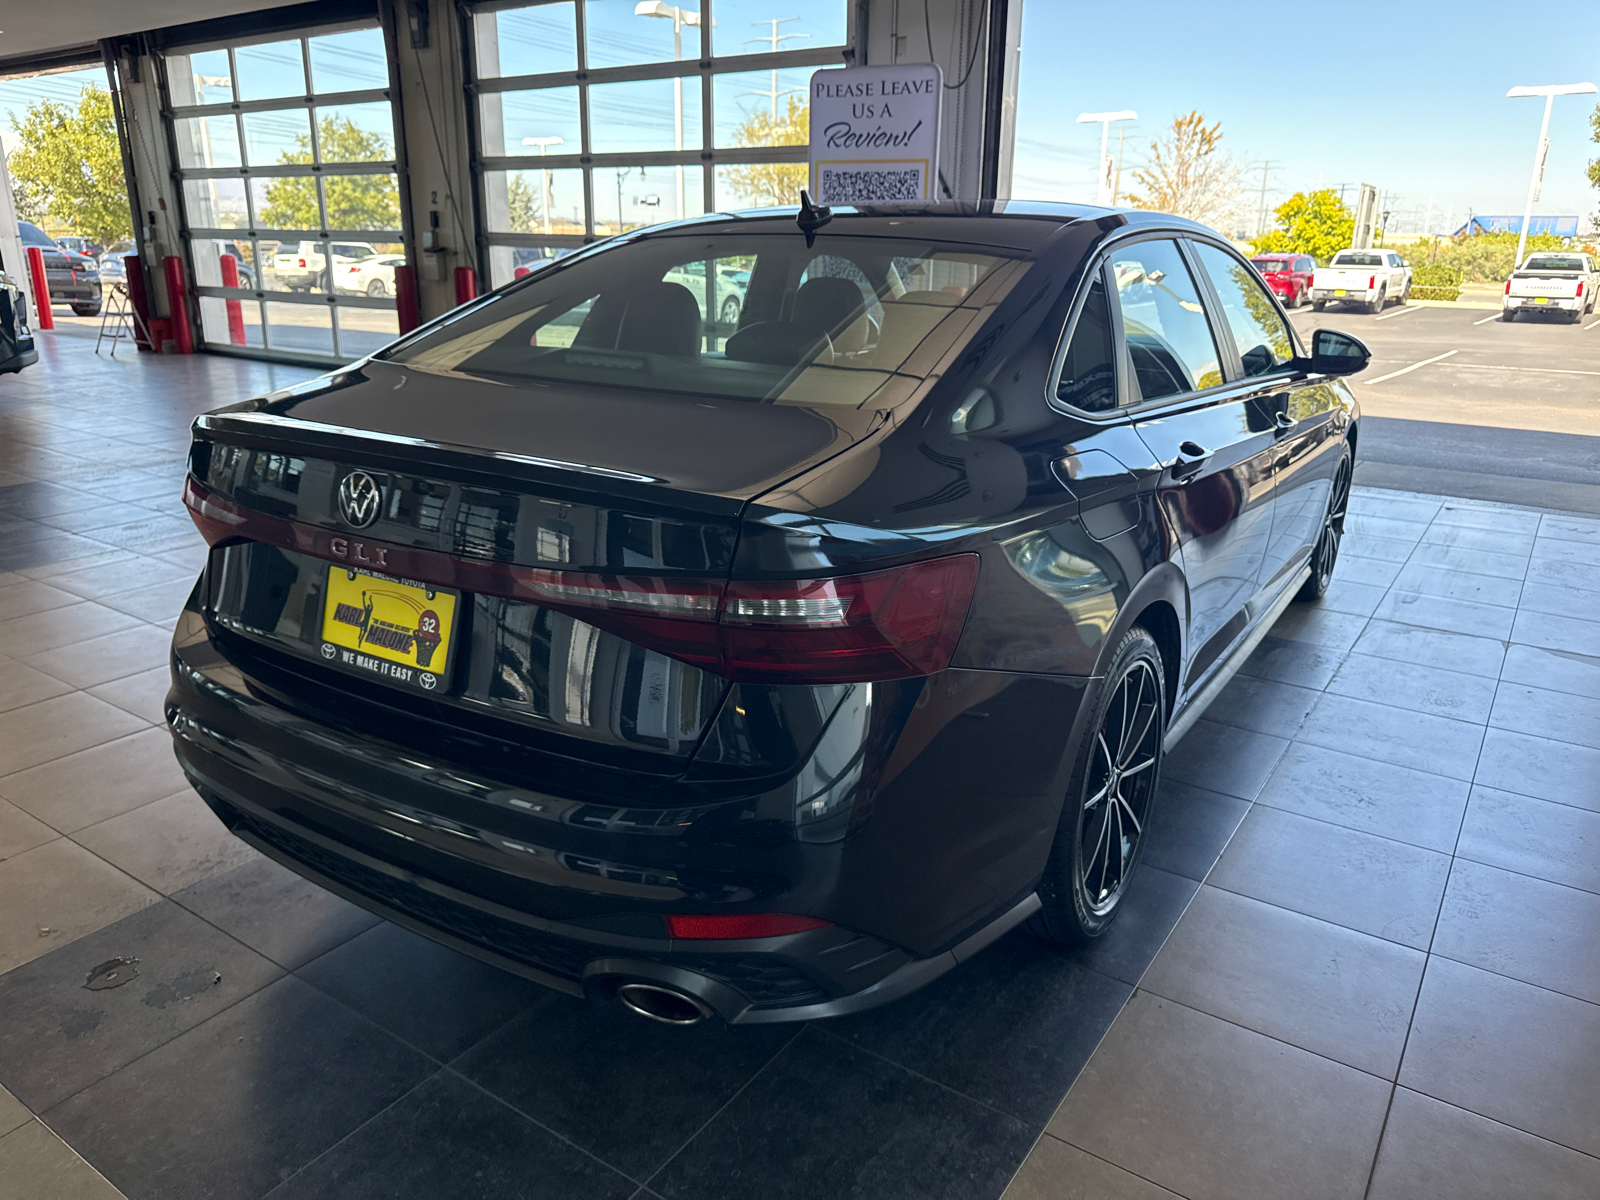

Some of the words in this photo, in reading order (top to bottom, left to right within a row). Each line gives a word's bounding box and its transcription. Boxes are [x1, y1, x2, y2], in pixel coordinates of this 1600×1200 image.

[815, 82, 874, 98] PLEASE
[881, 79, 934, 96] LEAVE
[852, 103, 875, 119] US
[880, 102, 893, 118] A
[823, 120, 922, 149] Review!
[431, 191, 438, 205] 2
[330, 537, 388, 567] GLI
[333, 602, 365, 628] KARL
[422, 617, 436, 634] 32
[365, 624, 414, 655] MALONE
[342, 650, 354, 664] WE
[356, 654, 379, 672] MAKE
[381, 662, 389, 675] IT
[390, 665, 413, 682] EASY
